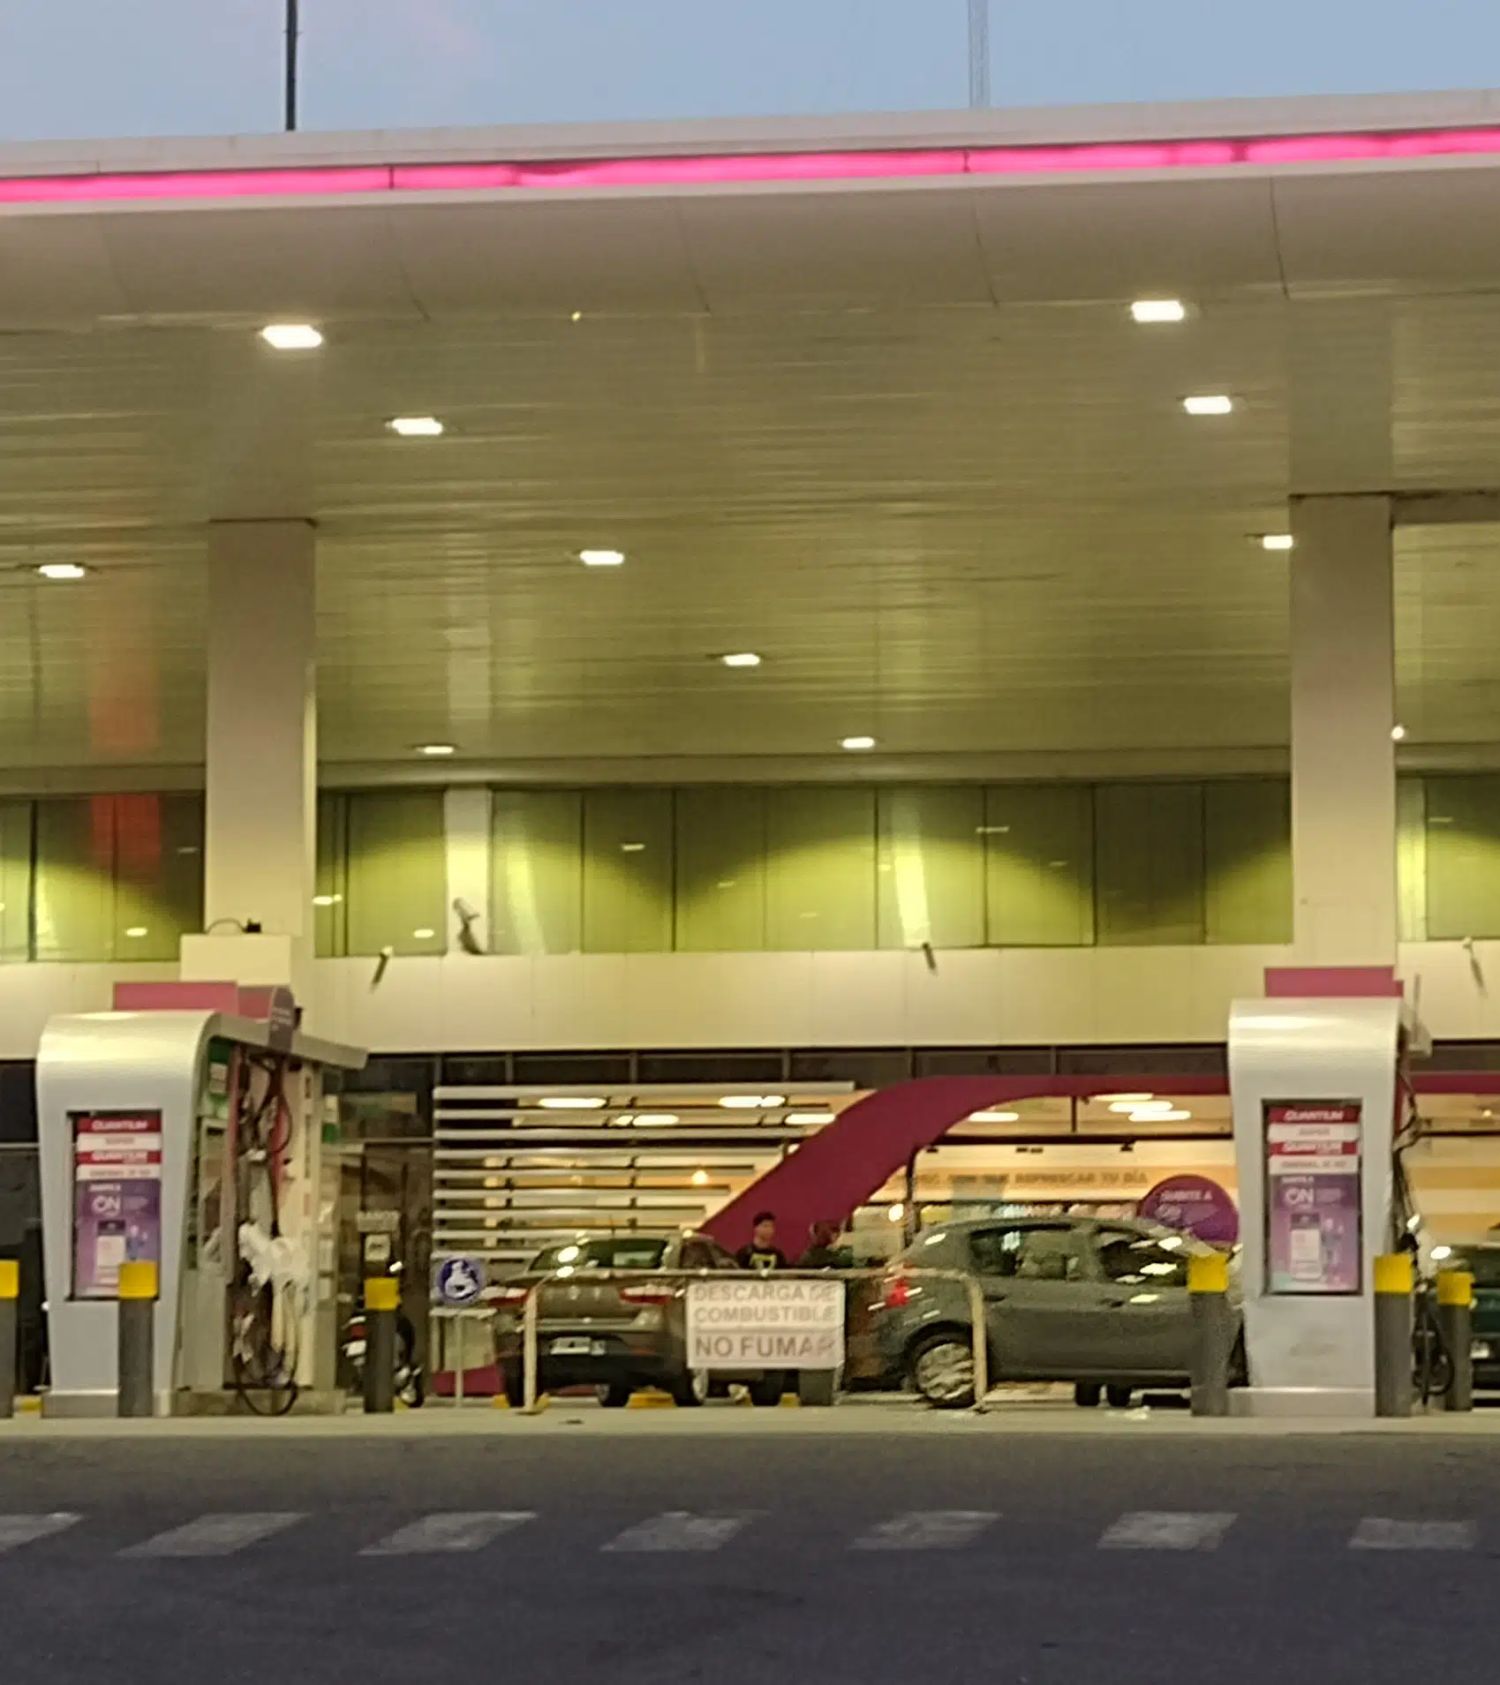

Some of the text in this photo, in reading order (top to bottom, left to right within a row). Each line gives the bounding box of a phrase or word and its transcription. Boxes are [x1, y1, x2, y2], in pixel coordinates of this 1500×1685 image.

[694, 1284, 804, 1301] DESCARGA
[694, 1306, 837, 1323] COMBUSTIBLE
[695, 1336, 835, 1357] NO FUMAR
